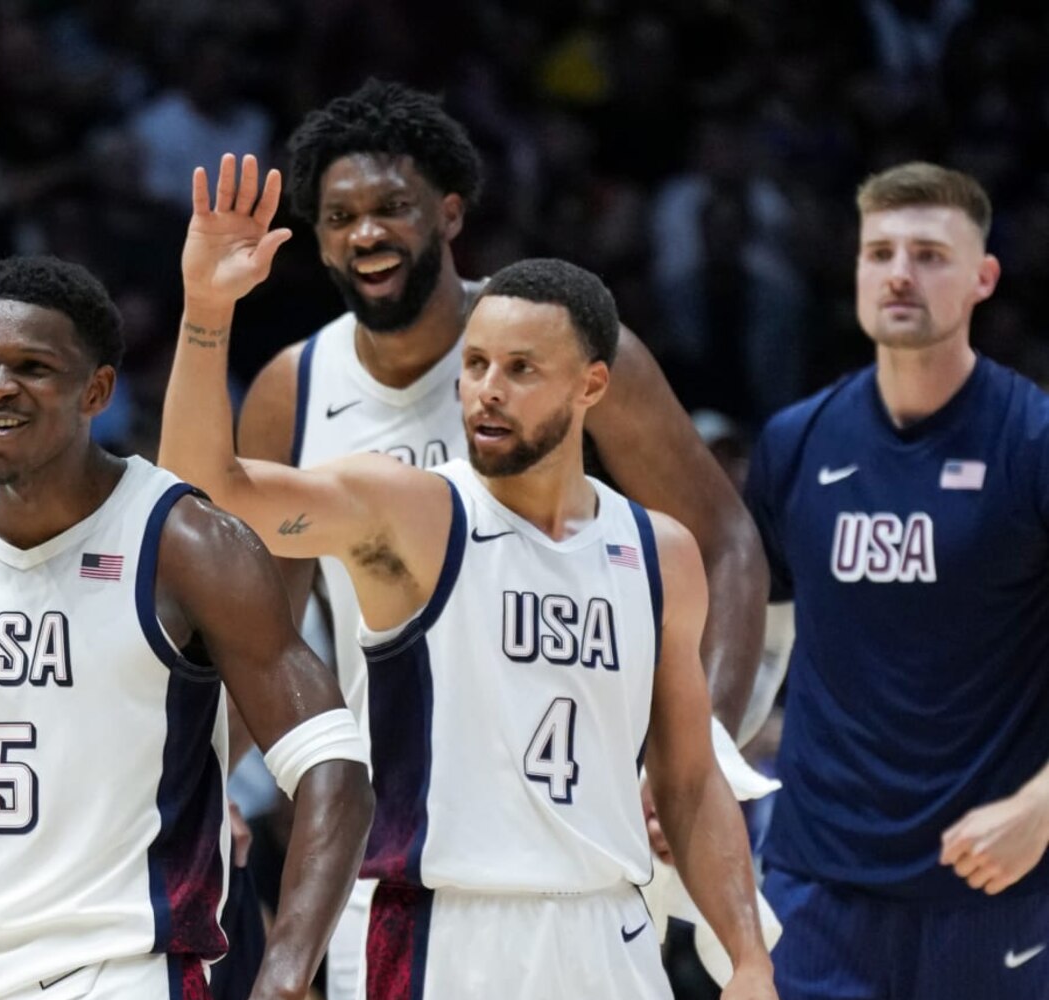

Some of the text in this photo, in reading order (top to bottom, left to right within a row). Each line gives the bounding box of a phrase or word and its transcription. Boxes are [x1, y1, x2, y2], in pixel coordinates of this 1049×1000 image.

[831, 511, 937, 583] USA
[502, 590, 620, 671] USA
[524, 697, 579, 804] 4
